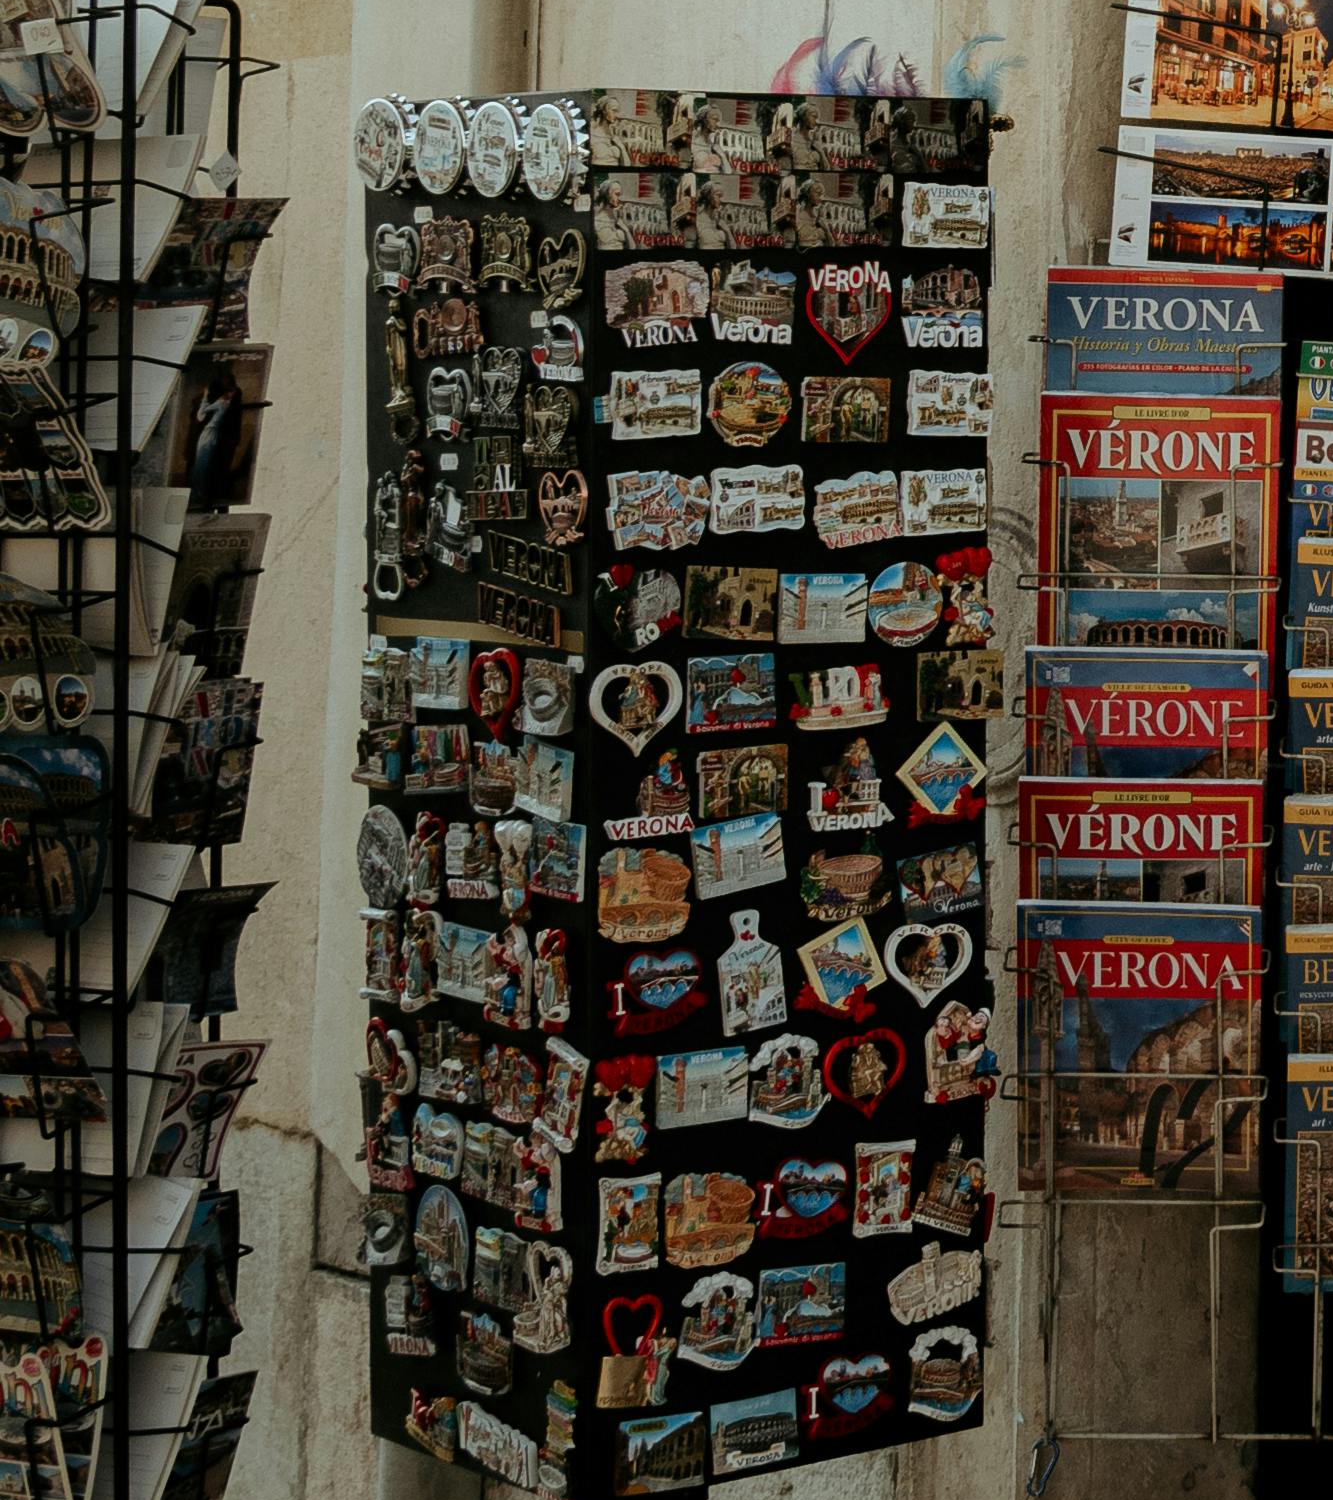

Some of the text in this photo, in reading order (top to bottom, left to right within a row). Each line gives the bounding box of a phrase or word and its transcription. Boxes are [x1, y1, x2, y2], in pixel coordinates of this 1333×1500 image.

[930, 187, 976, 198] VERONA
[809, 260, 892, 293] VERONA
[1067, 296, 1264, 332] VERONA
[622, 320, 697, 349] VERONA
[711, 313, 792, 345] Verona
[902, 317, 983, 348] Verona
[1072, 336, 1190, 355] Historia y Obras
[1065, 419, 1257, 475] VÉRONE
[926, 472, 973, 484] VERONA
[825, 523, 901, 549] VERONA
[813, 576, 844, 585] VERONA
[1308, 602, 1333, 613] Kunst
[1301, 681, 1328, 689] GUIDA
[1065, 692, 1245, 738] VÉRONE
[610, 816, 695, 839] VERONA
[812, 806, 895, 832] VERONA
[1044, 804, 1238, 854] VÉRONE
[1304, 862, 1322, 872] arte
[1057, 951, 1244, 990] VERONA
[1312, 1117, 1326, 1127] art
